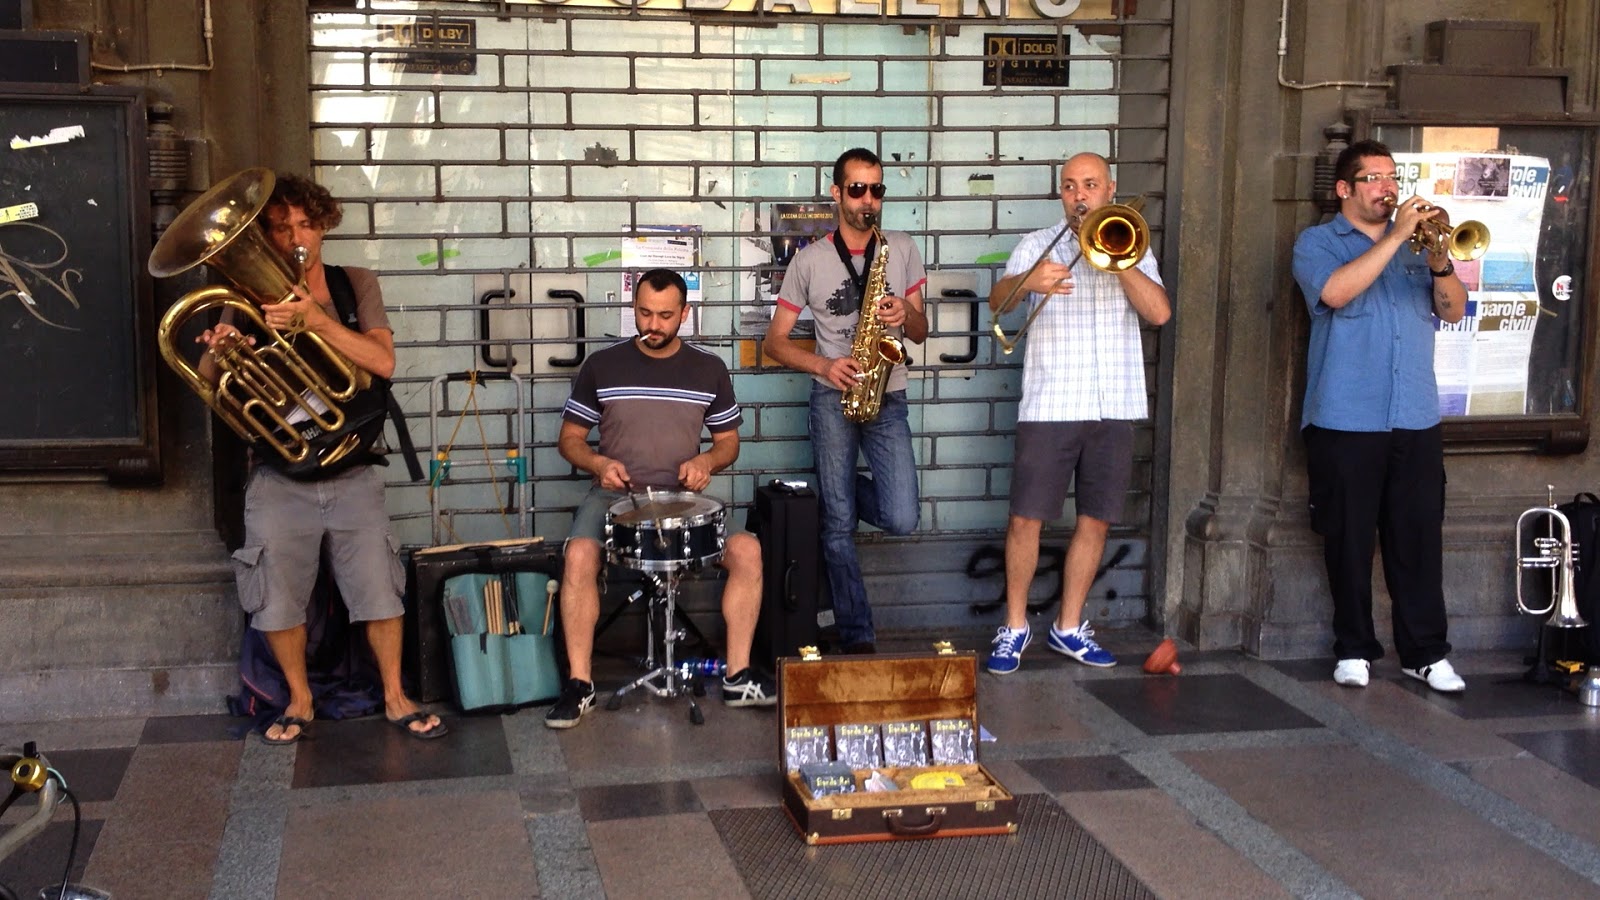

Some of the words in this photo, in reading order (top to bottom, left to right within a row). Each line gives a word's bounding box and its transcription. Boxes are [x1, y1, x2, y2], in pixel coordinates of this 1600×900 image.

[422, 27, 464, 40] DLBY
[1479, 301, 1527, 321] parole
[1499, 316, 1536, 331] civili
